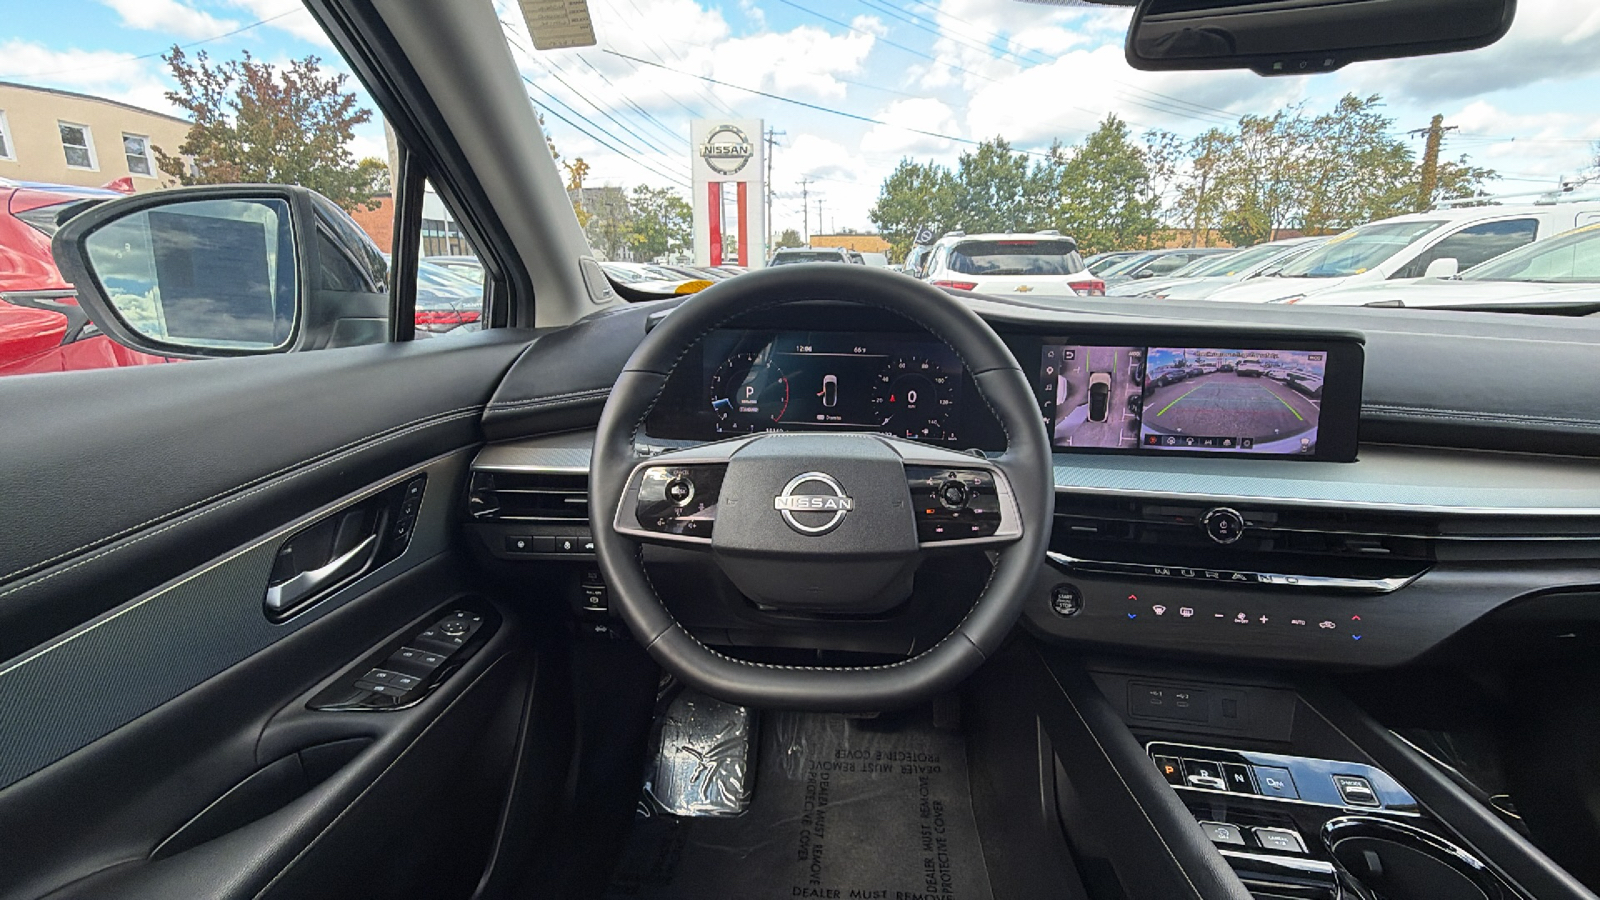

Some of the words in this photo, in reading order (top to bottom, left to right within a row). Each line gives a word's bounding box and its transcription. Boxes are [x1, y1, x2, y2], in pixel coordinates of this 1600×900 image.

[704, 146, 748, 154] NISSAN
[746, 386, 754, 398] P
[907, 390, 917, 403] 0
[777, 497, 851, 509] NISSAN
[1154, 567, 1299, 585] MURANO
[834, 749, 871, 760] COVER
[860, 762, 893, 773] MUST
[901, 764, 941, 775] DEALER
[1165, 765, 1174, 774] P
[1200, 769, 1209, 778] R
[1234, 773, 1245, 782] N
[919, 775, 931, 819] REMOVE
[933, 799, 945, 831] COVER
[812, 809, 826, 839] MUST
[922, 825, 934, 853] MUST
[809, 844, 824, 886] REMOVE
[935, 832, 953, 895] PROTECTIVE
[924, 857, 938, 894] DEALER
[792, 886, 841, 899] DEALER
[849, 889, 888, 900] MUST
